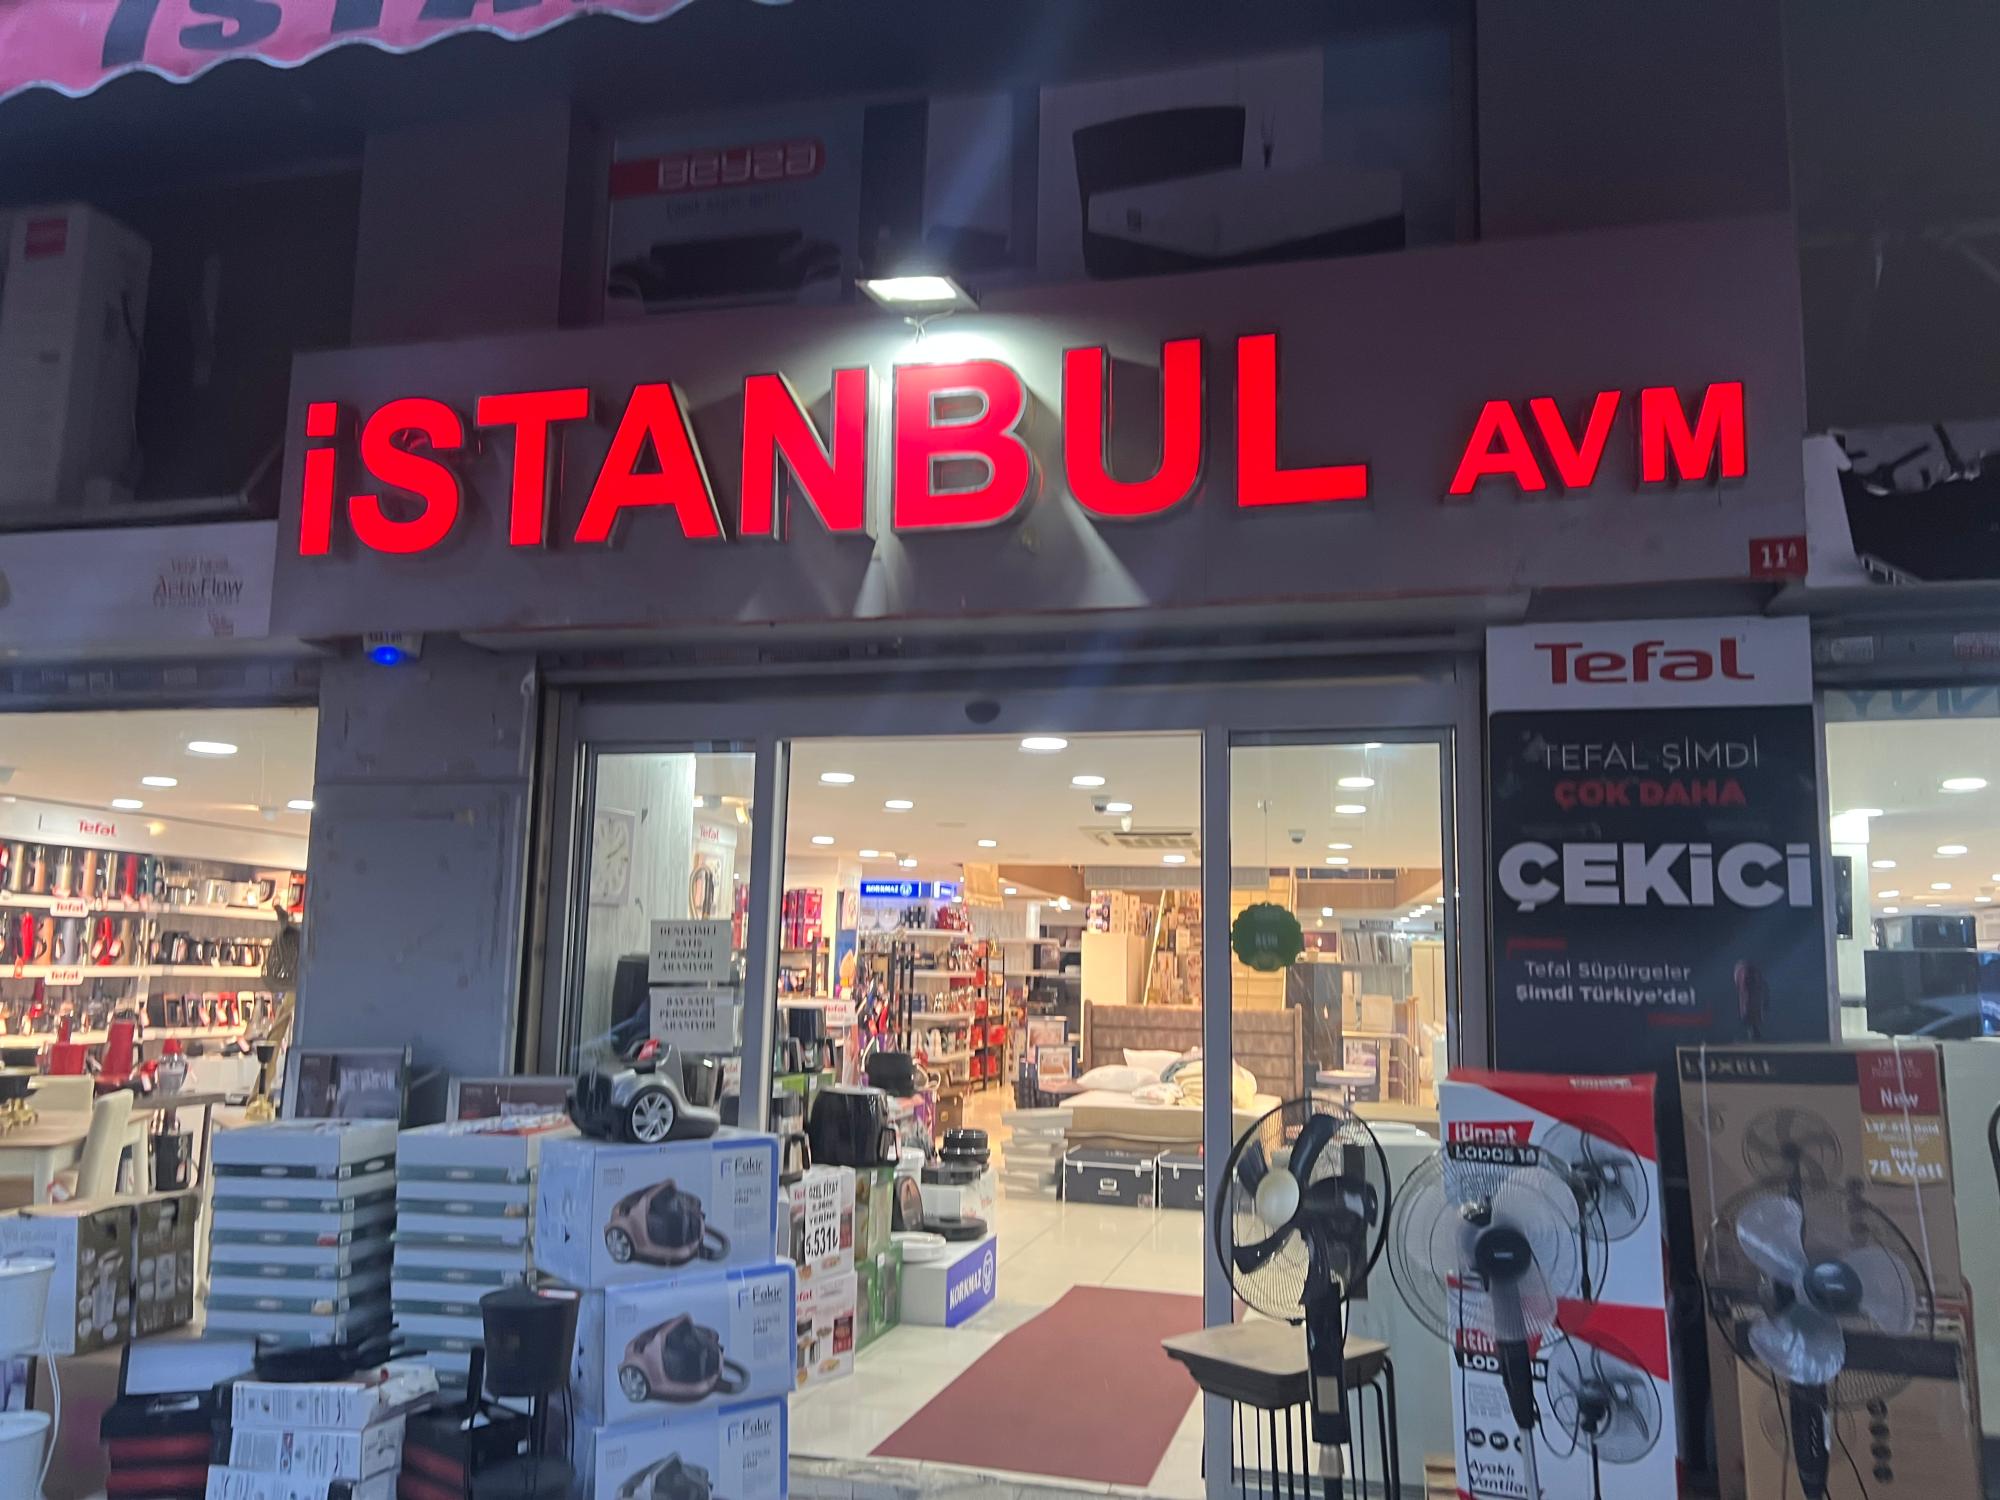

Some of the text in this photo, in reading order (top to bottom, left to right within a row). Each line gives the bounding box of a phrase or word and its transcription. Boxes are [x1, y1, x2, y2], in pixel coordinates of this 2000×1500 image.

[1449, 380, 1746, 496] AVM
[1534, 636, 1755, 684] Tefal
[1543, 741, 1649, 771] TEFAL
[1554, 778, 1748, 812] ÇOK DAHA
[79, 819, 118, 837] Tefal
[1525, 961, 1691, 983] Tefal Süpürgeler
[949, 1267, 982, 1311] KORKMAZ
[1470, 1474, 1546, 1497] Vantila
